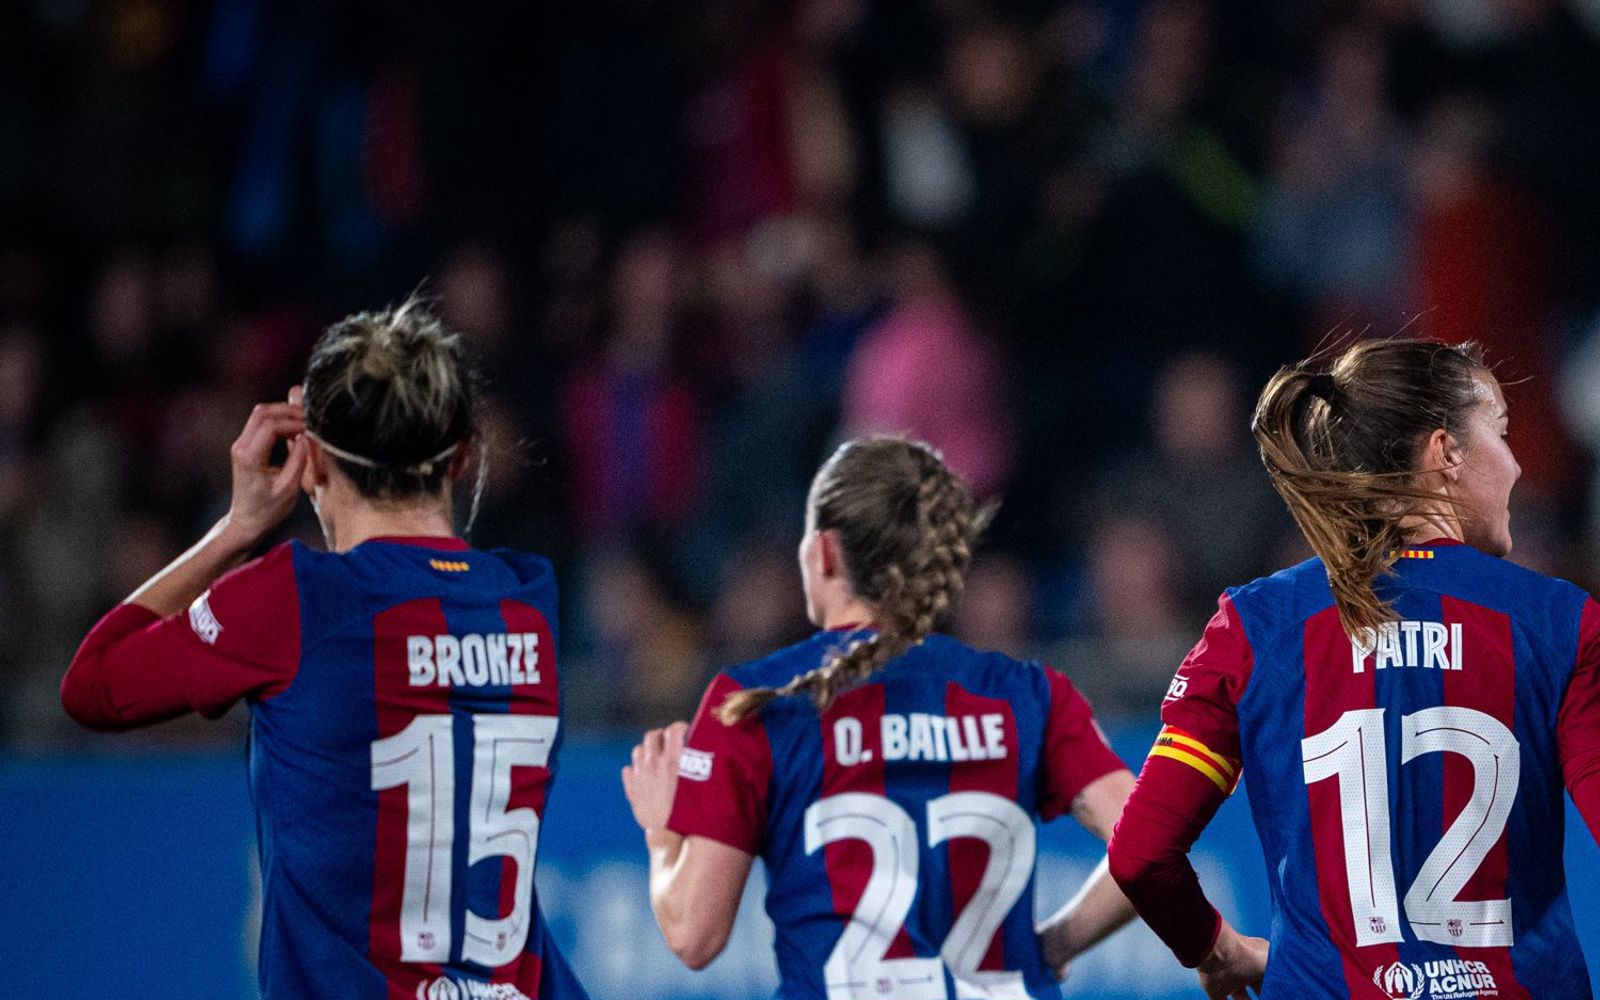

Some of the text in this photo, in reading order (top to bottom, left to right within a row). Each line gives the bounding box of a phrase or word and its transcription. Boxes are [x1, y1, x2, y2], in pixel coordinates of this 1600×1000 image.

[406, 632, 541, 687] BRONZE
[1351, 620, 1463, 674] PATRI
[835, 712, 1008, 767] O. BATLLE
[370, 713, 560, 968] 15
[1301, 706, 1521, 948] 12
[1424, 958, 1491, 979] UNHCR
[1429, 973, 1497, 994] ACNUR
